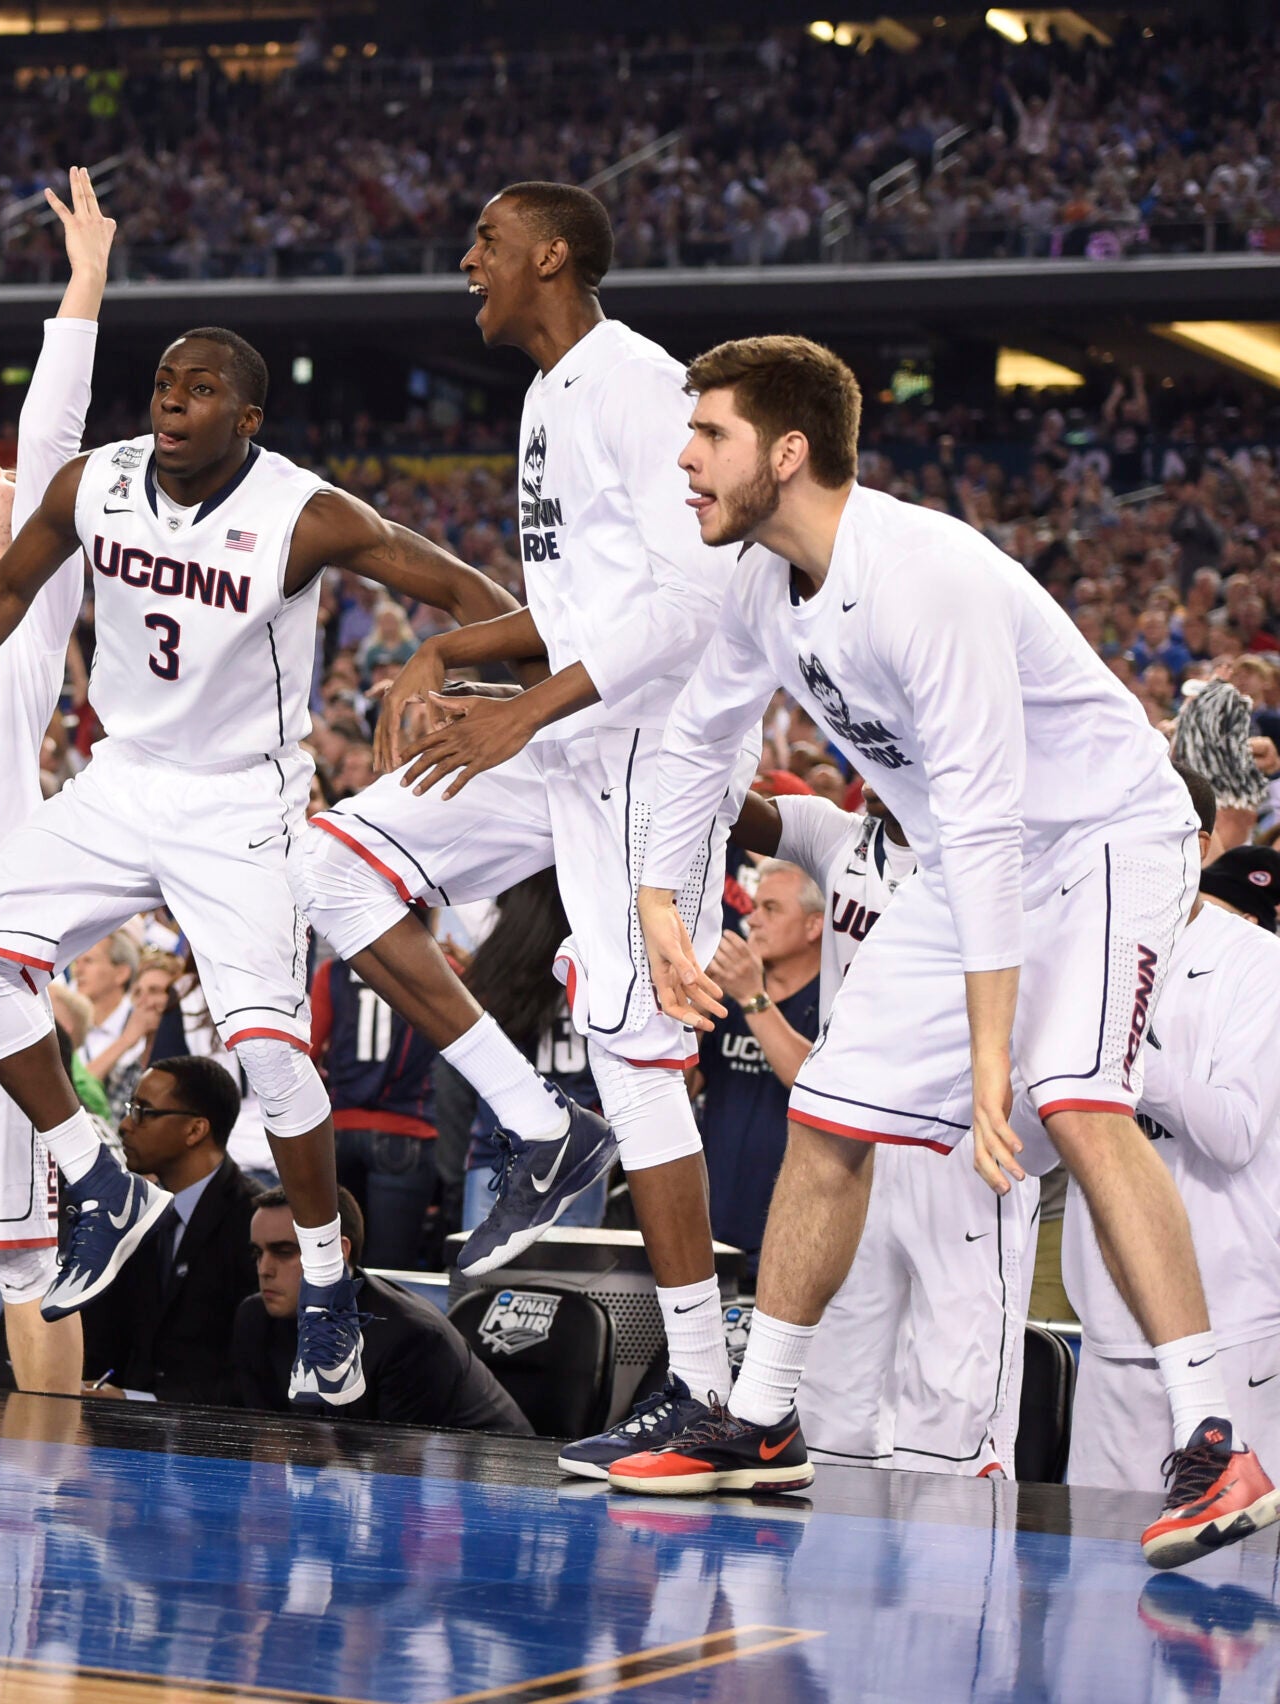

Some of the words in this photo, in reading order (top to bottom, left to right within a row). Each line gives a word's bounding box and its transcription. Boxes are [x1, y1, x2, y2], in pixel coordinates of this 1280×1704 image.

[94, 535, 251, 613] UCONN
[145, 613, 180, 681] 3
[484, 1304, 550, 1334] FOUR
[507, 1295, 554, 1316] FINAL
